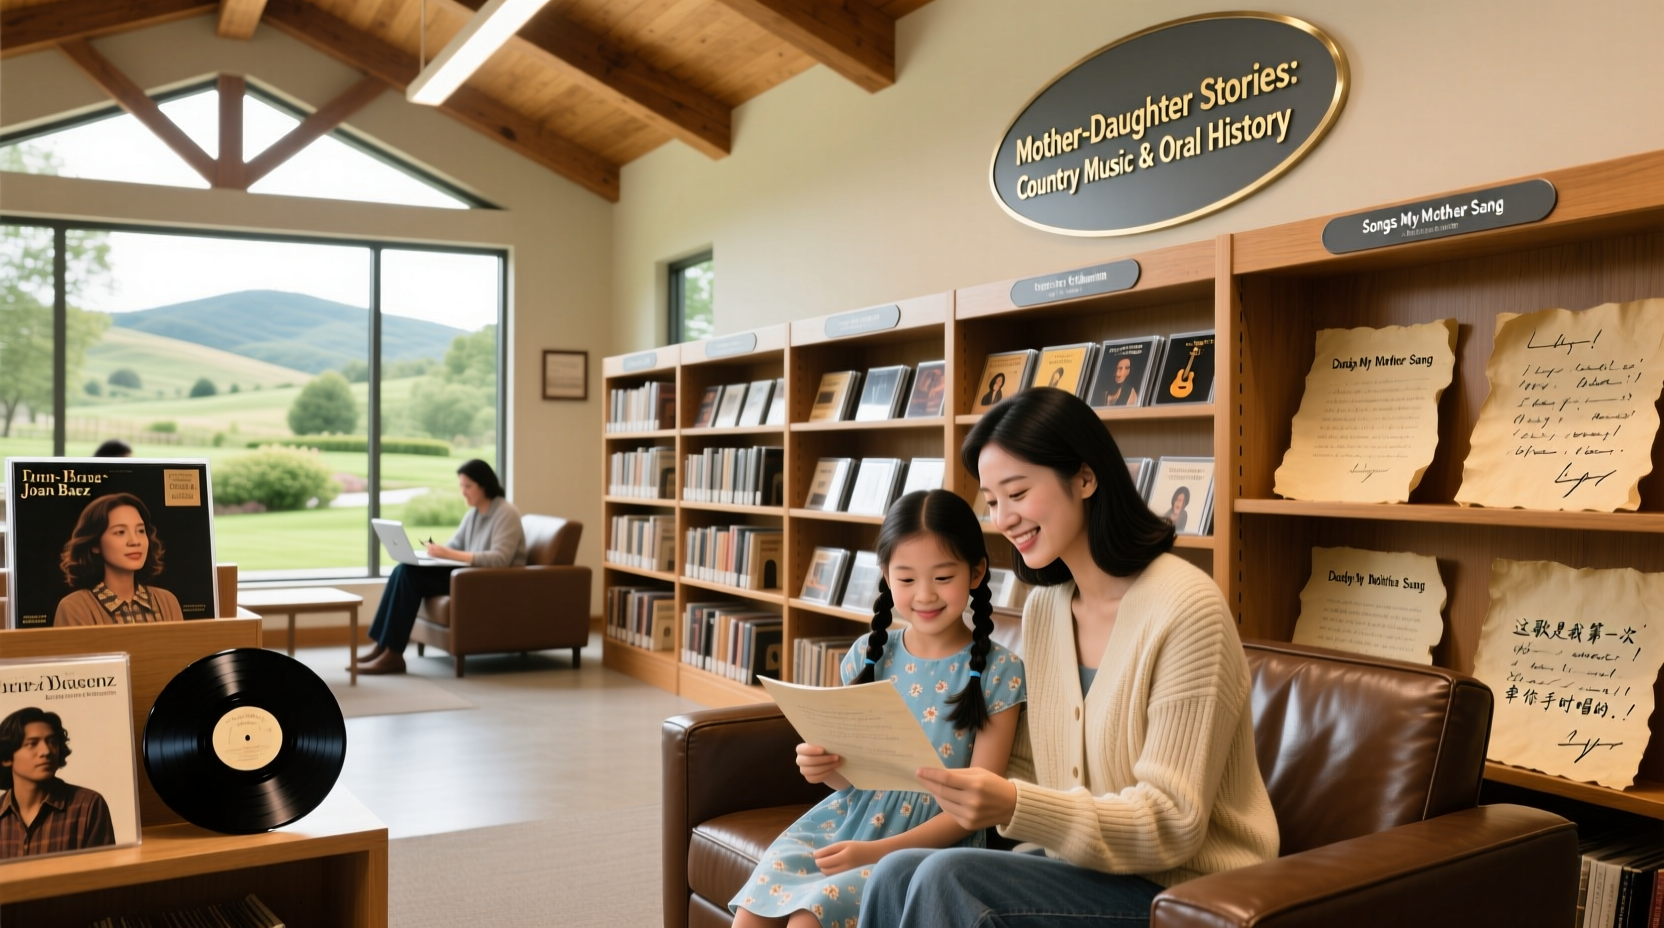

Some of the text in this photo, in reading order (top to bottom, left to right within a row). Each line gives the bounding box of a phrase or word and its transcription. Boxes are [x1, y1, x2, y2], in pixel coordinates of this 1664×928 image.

[1016, 60, 1299, 165] Mother-Daughter Stories:
[1016, 108, 1293, 200] Country Music & Oral History
[1362, 217, 1398, 235] Songs
[1400, 211, 1420, 229] My
[1421, 204, 1468, 223] Mother
[1471, 199, 1504, 216] Sang
[1409, 354, 1433, 368] Sang
[20, 483, 55, 499] Joan
